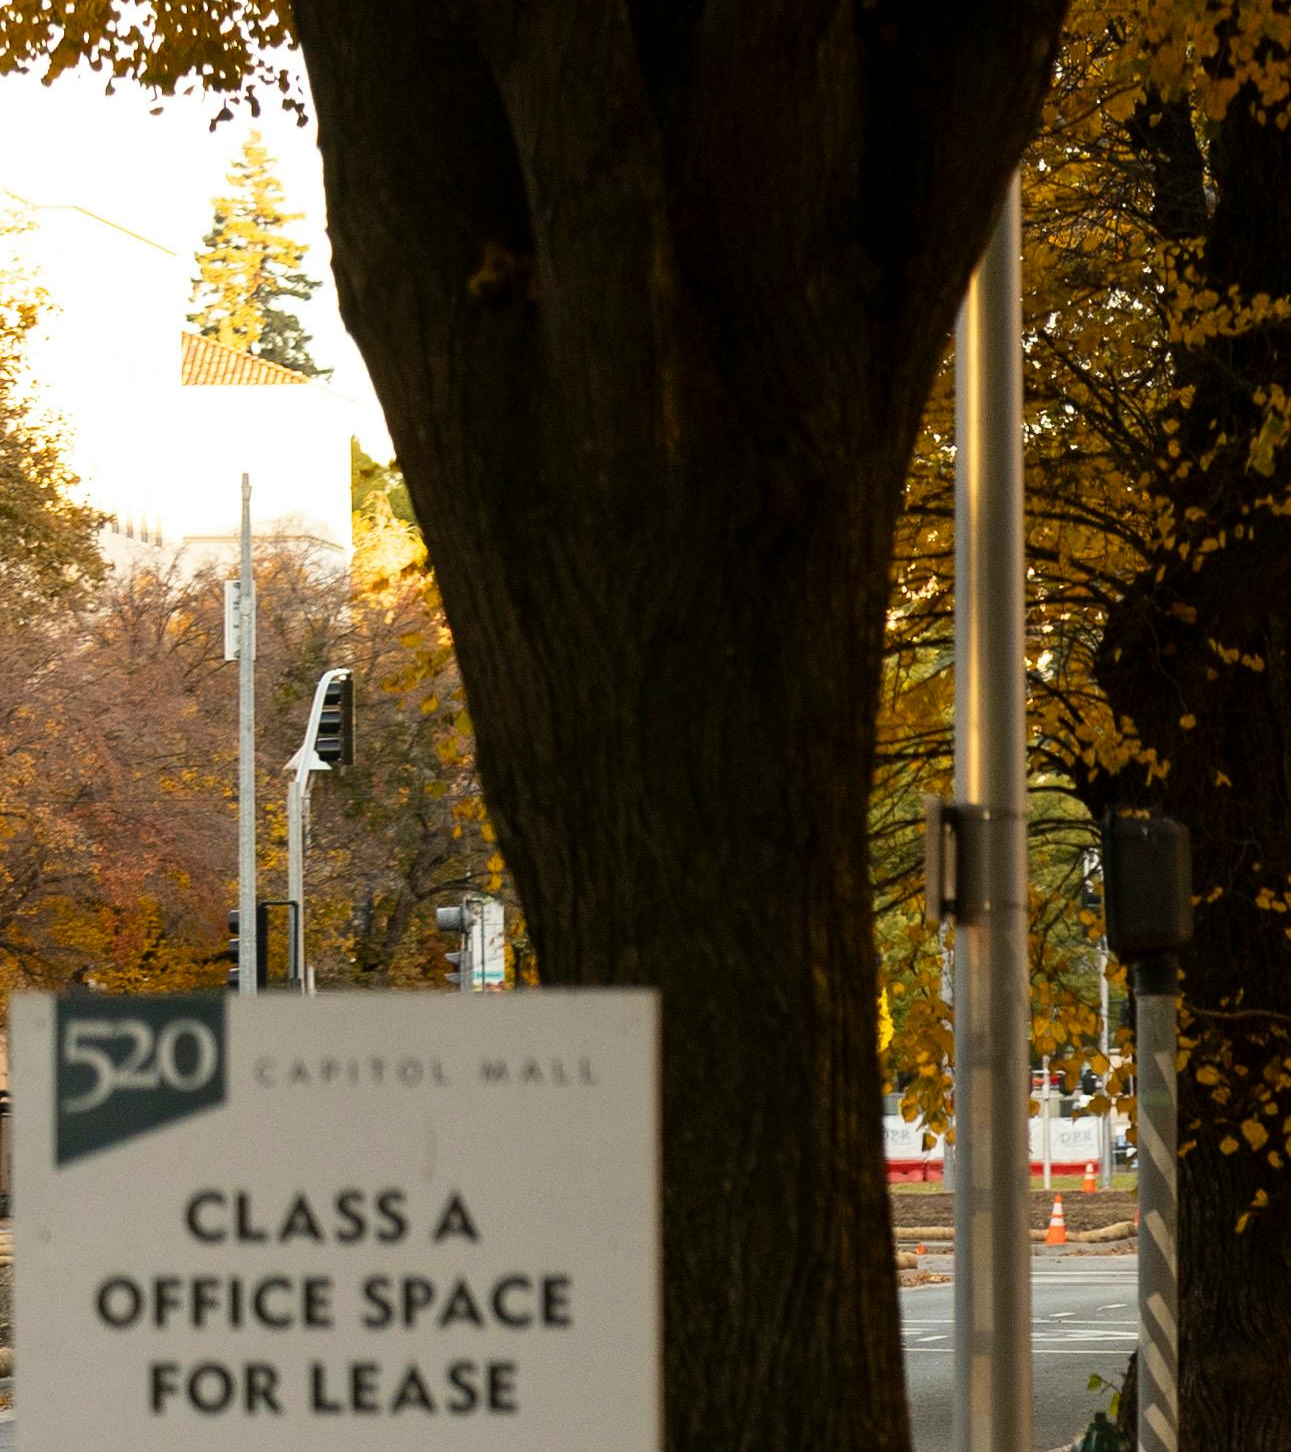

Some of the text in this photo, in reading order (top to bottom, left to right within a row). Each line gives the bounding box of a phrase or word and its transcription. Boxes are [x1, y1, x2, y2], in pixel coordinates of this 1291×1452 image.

[64, 1018, 218, 1114] 520
[253, 1055, 600, 1087] CAPITOL MALL
[184, 1188, 480, 1245] CLASS A
[94, 1272, 573, 1331] OFFICE SPACE
[149, 1359, 518, 1416] FOR LEASE
